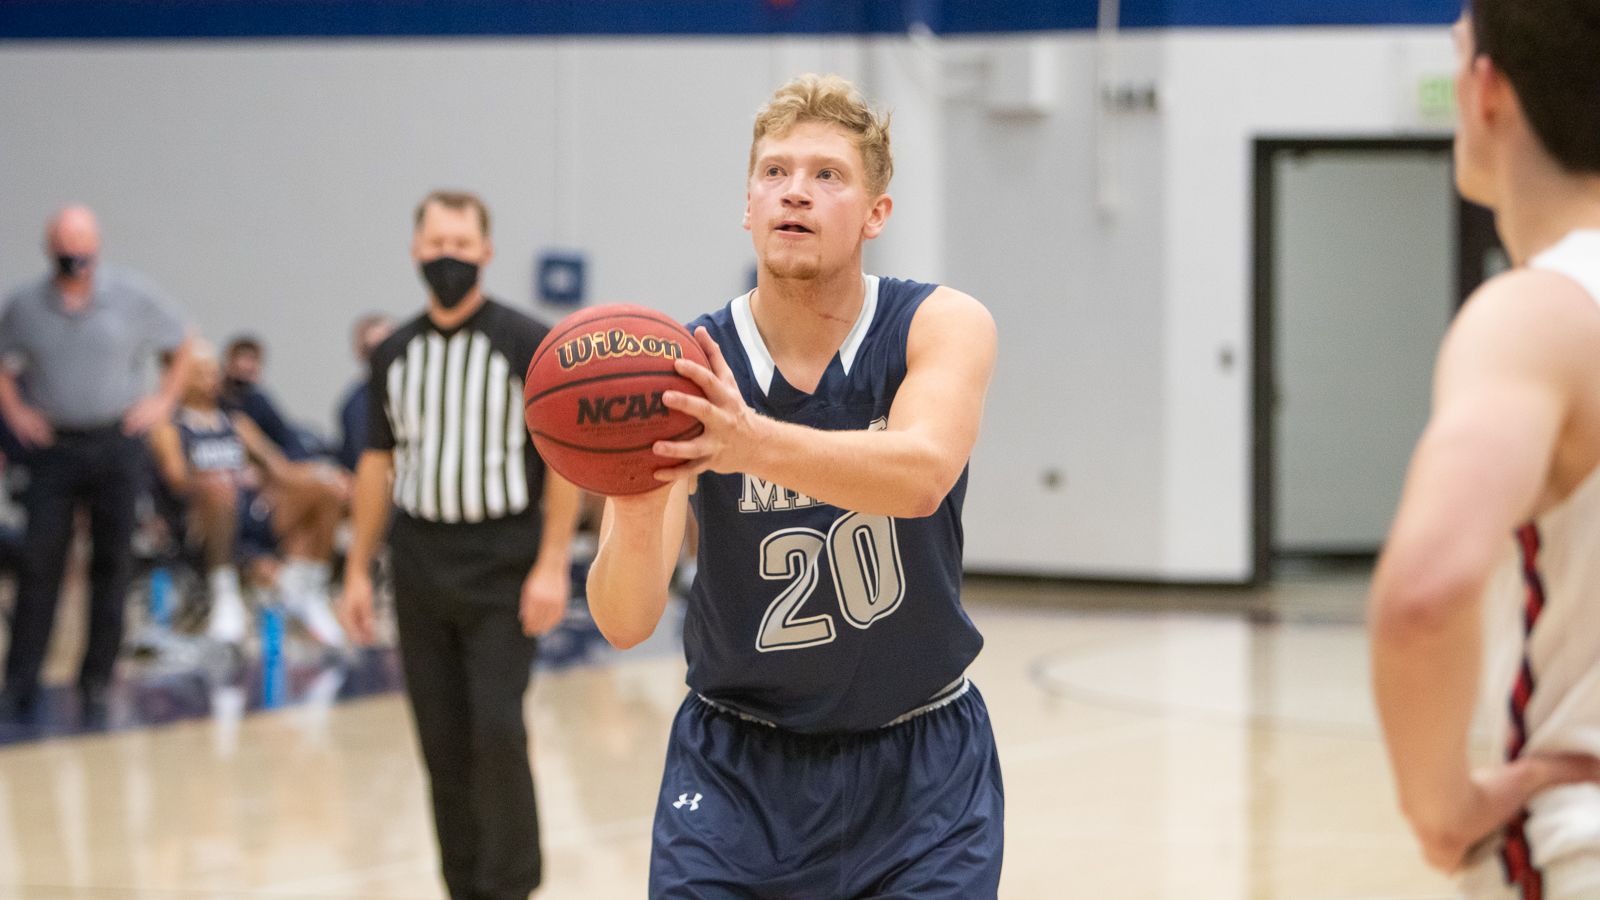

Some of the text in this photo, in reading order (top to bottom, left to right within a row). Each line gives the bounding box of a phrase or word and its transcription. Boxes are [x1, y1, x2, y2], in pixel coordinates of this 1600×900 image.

[555, 327, 683, 371] Wilson
[577, 391, 669, 425] NCAA
[755, 510, 906, 653] 20
